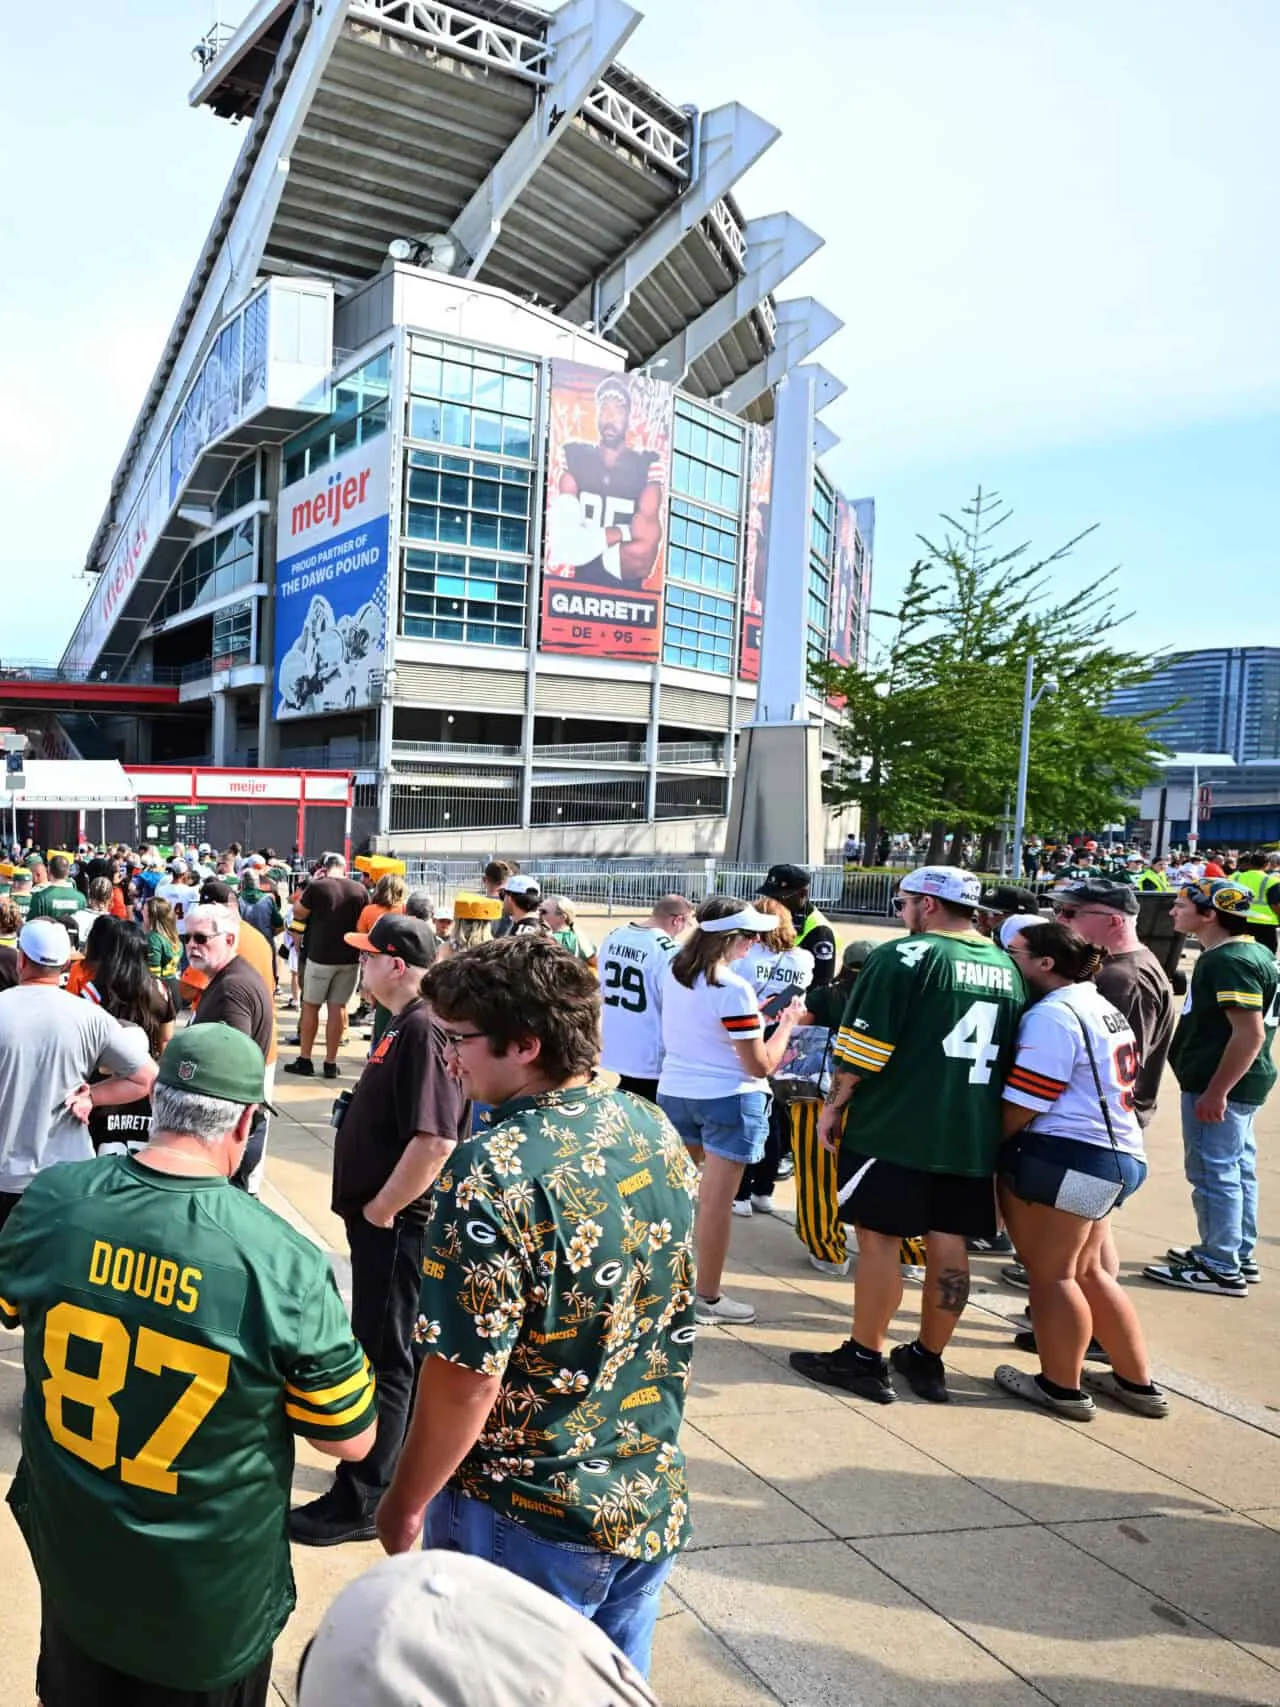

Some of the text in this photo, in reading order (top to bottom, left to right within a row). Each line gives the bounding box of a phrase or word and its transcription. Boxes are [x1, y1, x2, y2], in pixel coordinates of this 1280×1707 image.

[291, 467, 371, 536] meijer
[281, 547, 380, 599] THE DAWG POUND
[291, 534, 368, 575] PROUD PARTNER OF
[551, 593, 654, 623] GARRETT
[572, 626, 633, 643] DE 95
[229, 780, 268, 795] meijer
[756, 965, 806, 984] PARSONS
[895, 940, 932, 968] 4
[604, 960, 647, 1014] 29
[955, 960, 1013, 992] FAVRE
[941, 1001, 1000, 1085] 4
[88, 1240, 204, 1314] DOUBS
[42, 1301, 231, 1496] 87
